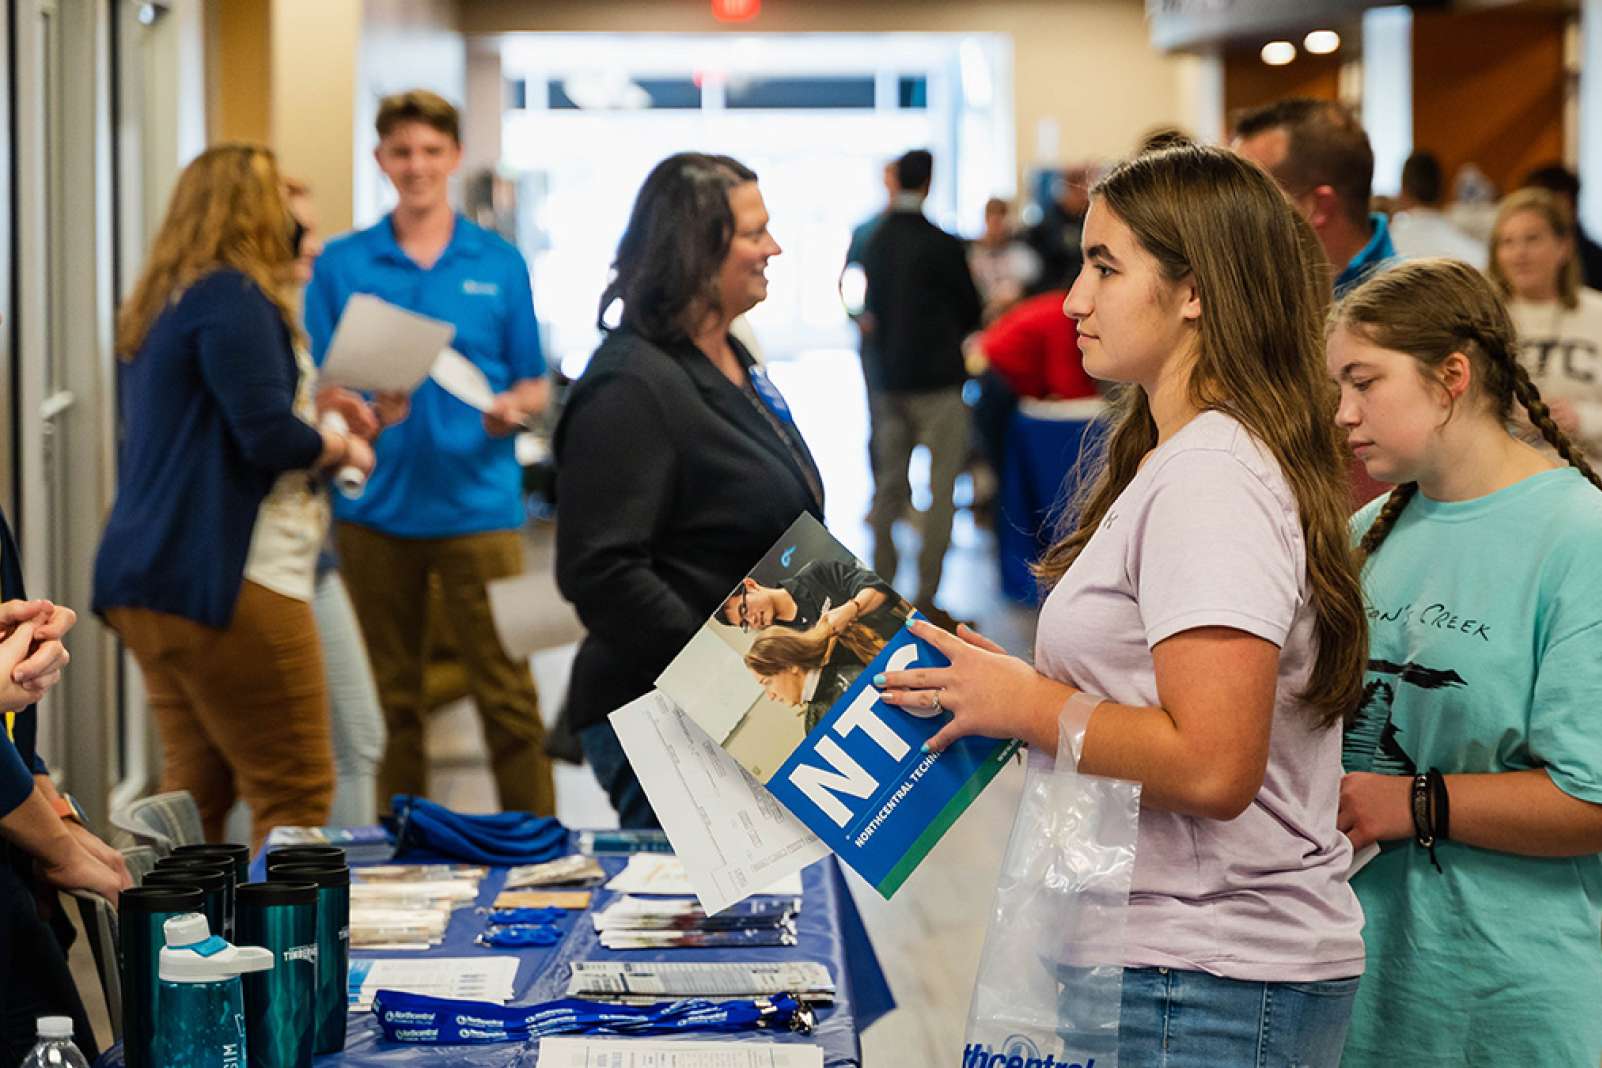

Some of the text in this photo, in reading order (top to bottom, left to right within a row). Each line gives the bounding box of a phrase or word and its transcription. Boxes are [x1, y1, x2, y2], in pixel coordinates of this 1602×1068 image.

[1520, 338, 1599, 383] TC
[1420, 602, 1491, 642] CREEK
[854, 781, 914, 848] NORTHCENTRAL
